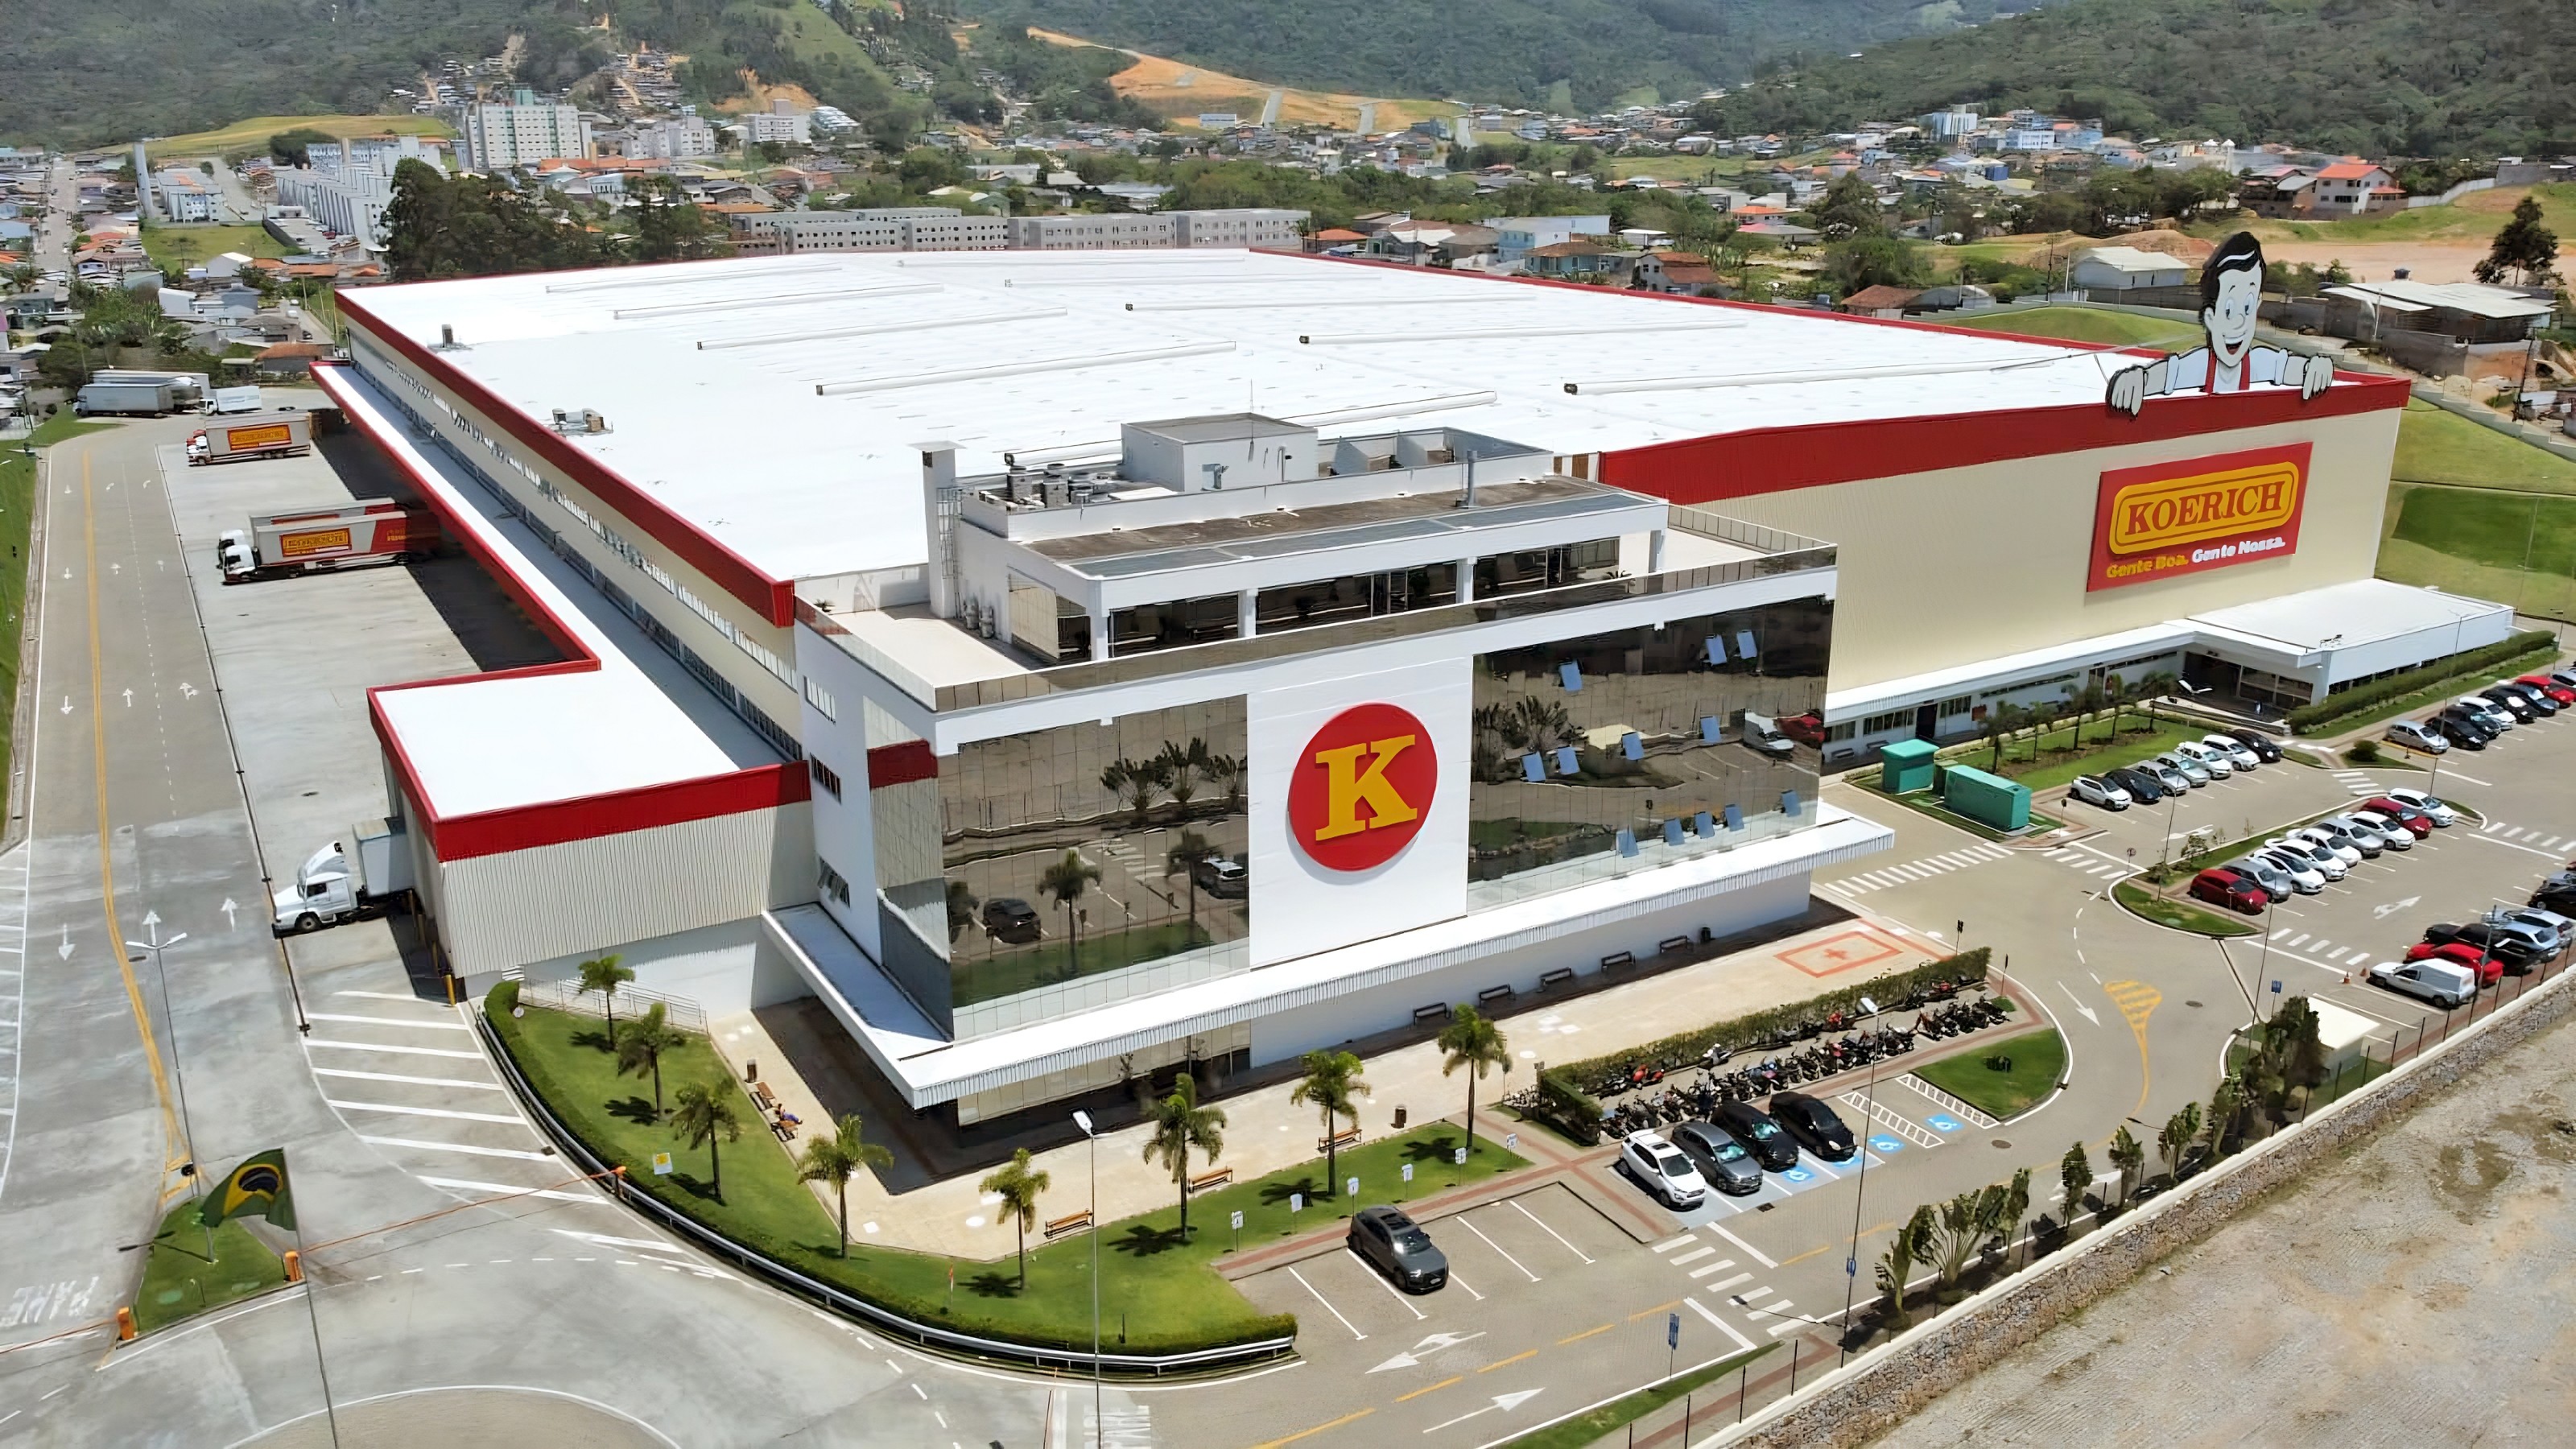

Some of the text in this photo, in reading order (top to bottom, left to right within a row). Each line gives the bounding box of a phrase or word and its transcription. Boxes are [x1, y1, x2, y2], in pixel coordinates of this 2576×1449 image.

[2124, 481, 2285, 536] KOERICH
[2192, 544, 2235, 563] Gente
[1315, 734, 1418, 841] K
